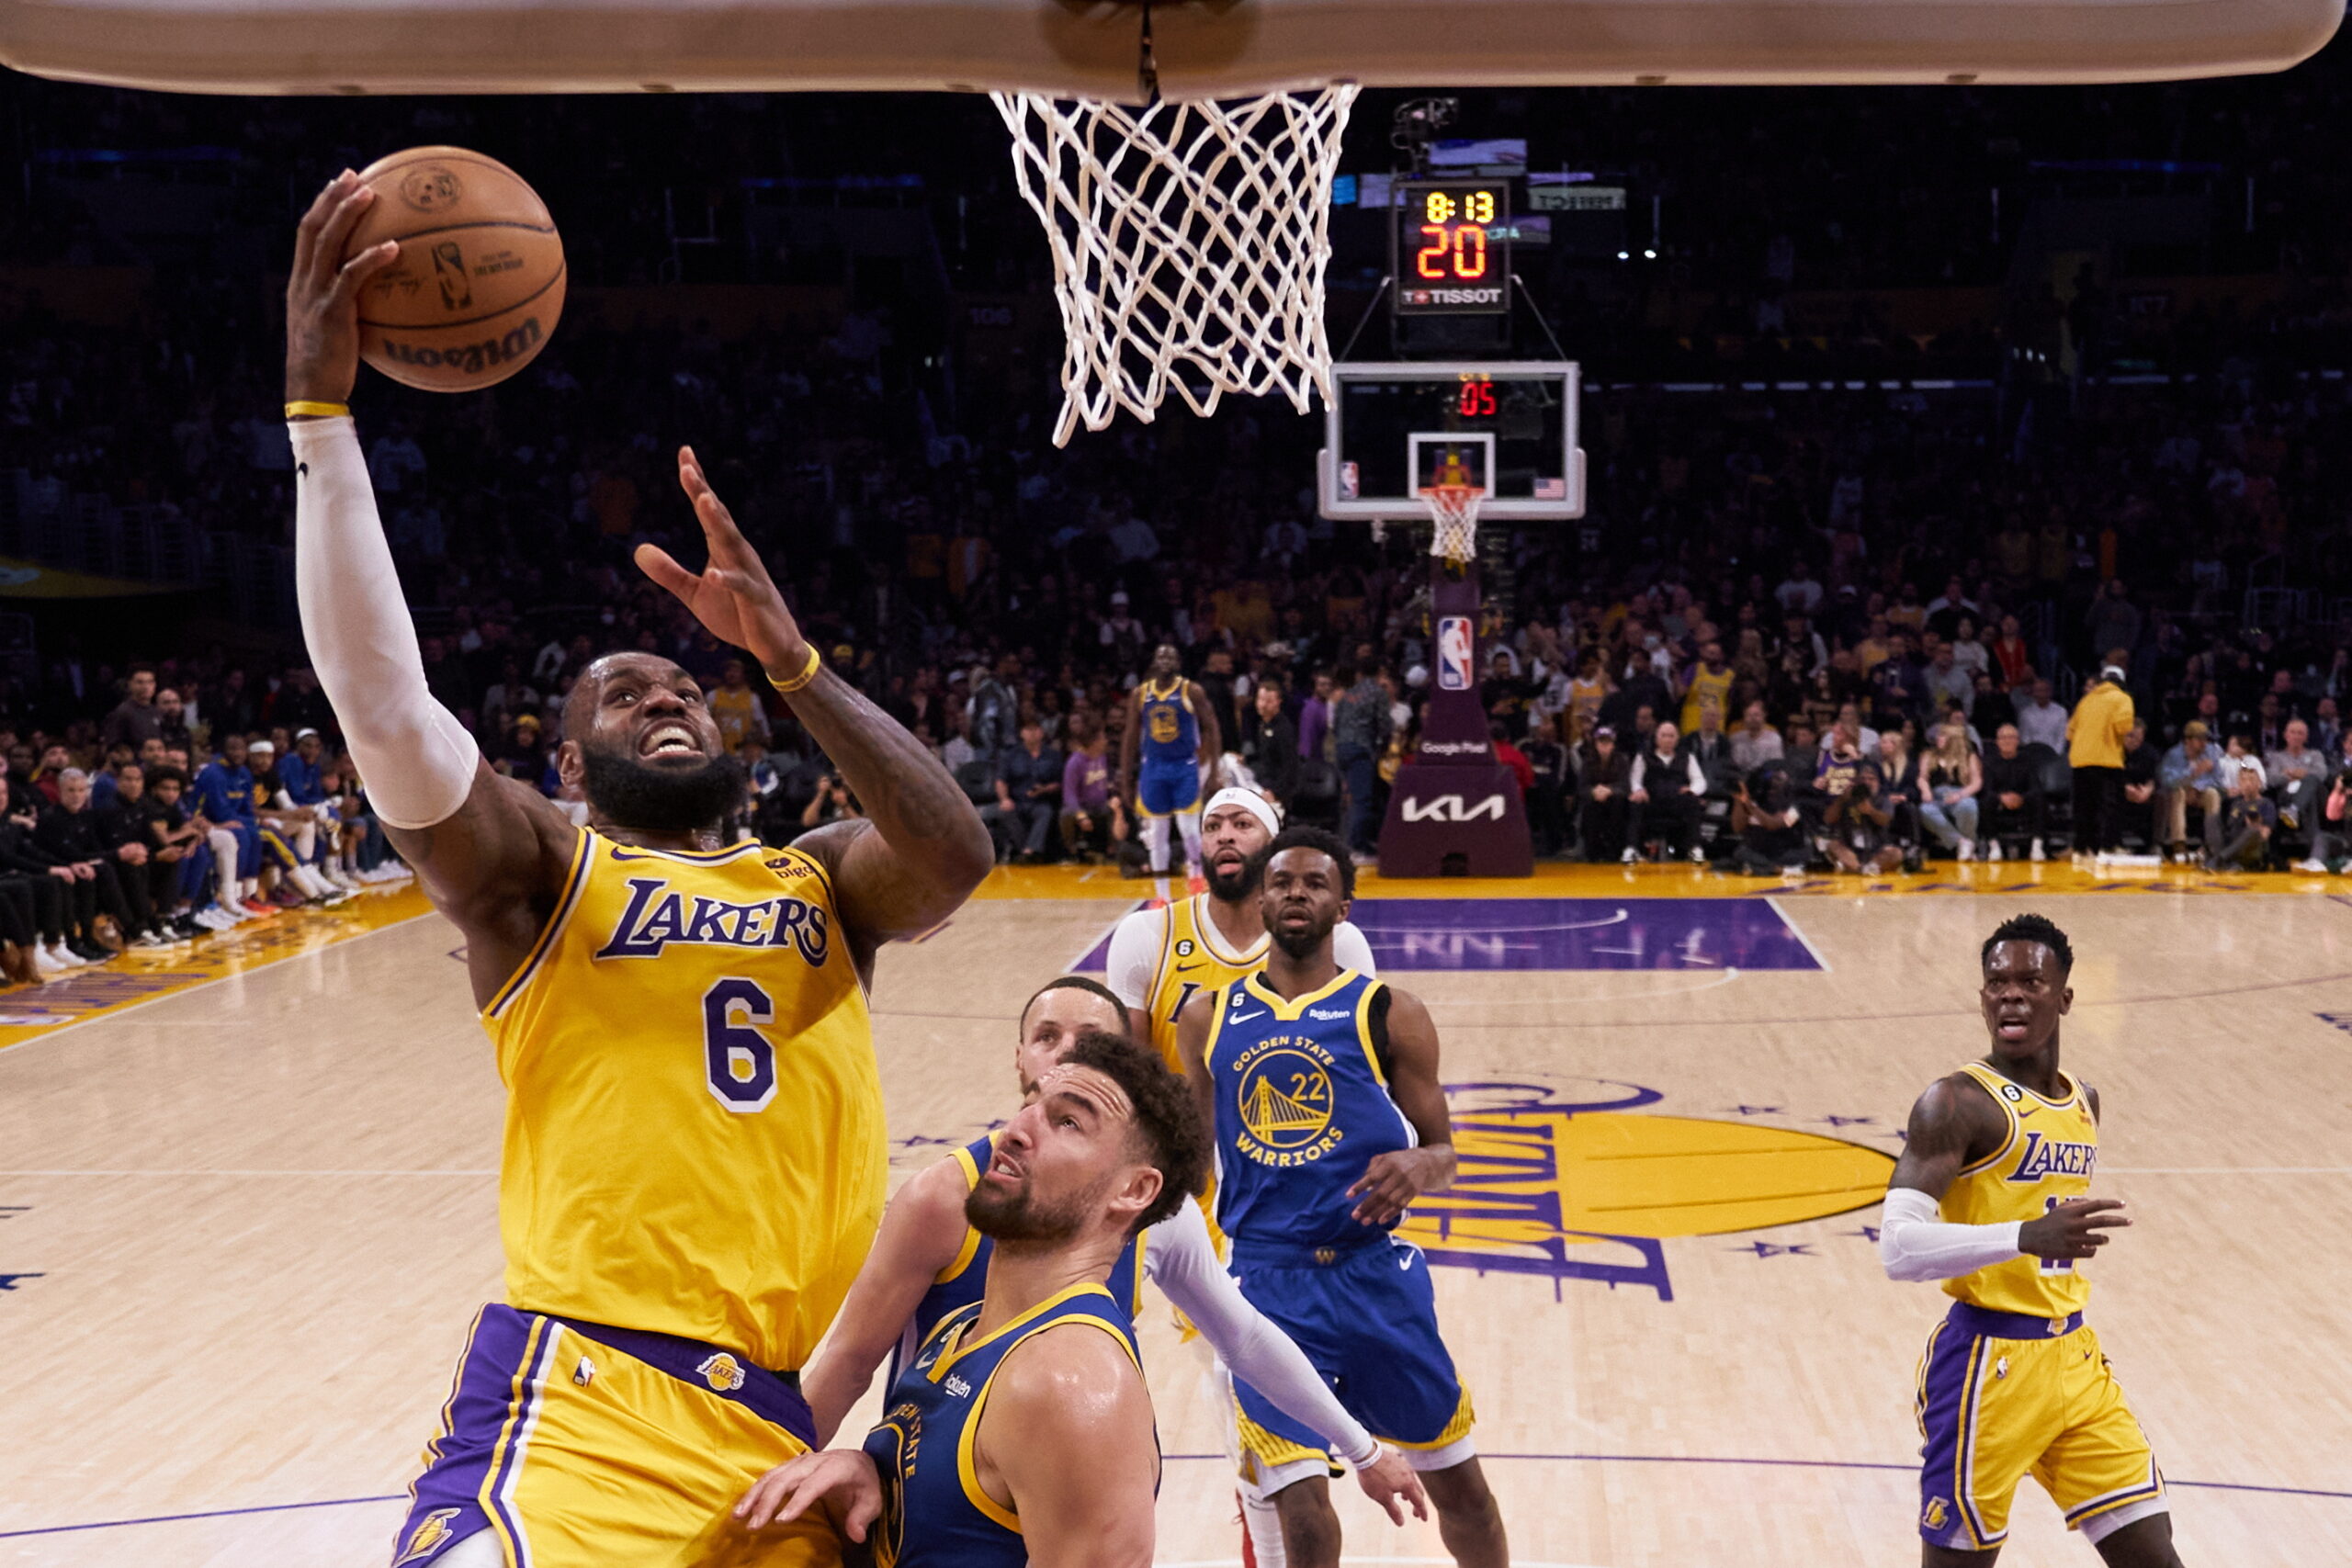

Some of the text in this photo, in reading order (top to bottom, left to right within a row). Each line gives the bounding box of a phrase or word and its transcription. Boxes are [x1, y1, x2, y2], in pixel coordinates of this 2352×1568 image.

[1427, 191, 1494, 223] 8:13
[1418, 225, 1487, 278] 20
[1430, 289, 1502, 304] TISSOT
[1422, 742, 1461, 756] Google
[594, 878, 829, 968] LAKERS
[1177, 941, 1192, 956] 6
[1231, 992, 1246, 1008] 6
[1308, 1009, 1351, 1021] Rakuten
[701, 976, 778, 1113] 6
[1232, 1035, 1335, 1072] GOLDEN STATE
[1291, 1072, 1326, 1100] 22
[2004, 1085, 2021, 1101] 6
[1236, 1126, 1343, 1167] WARRIORS
